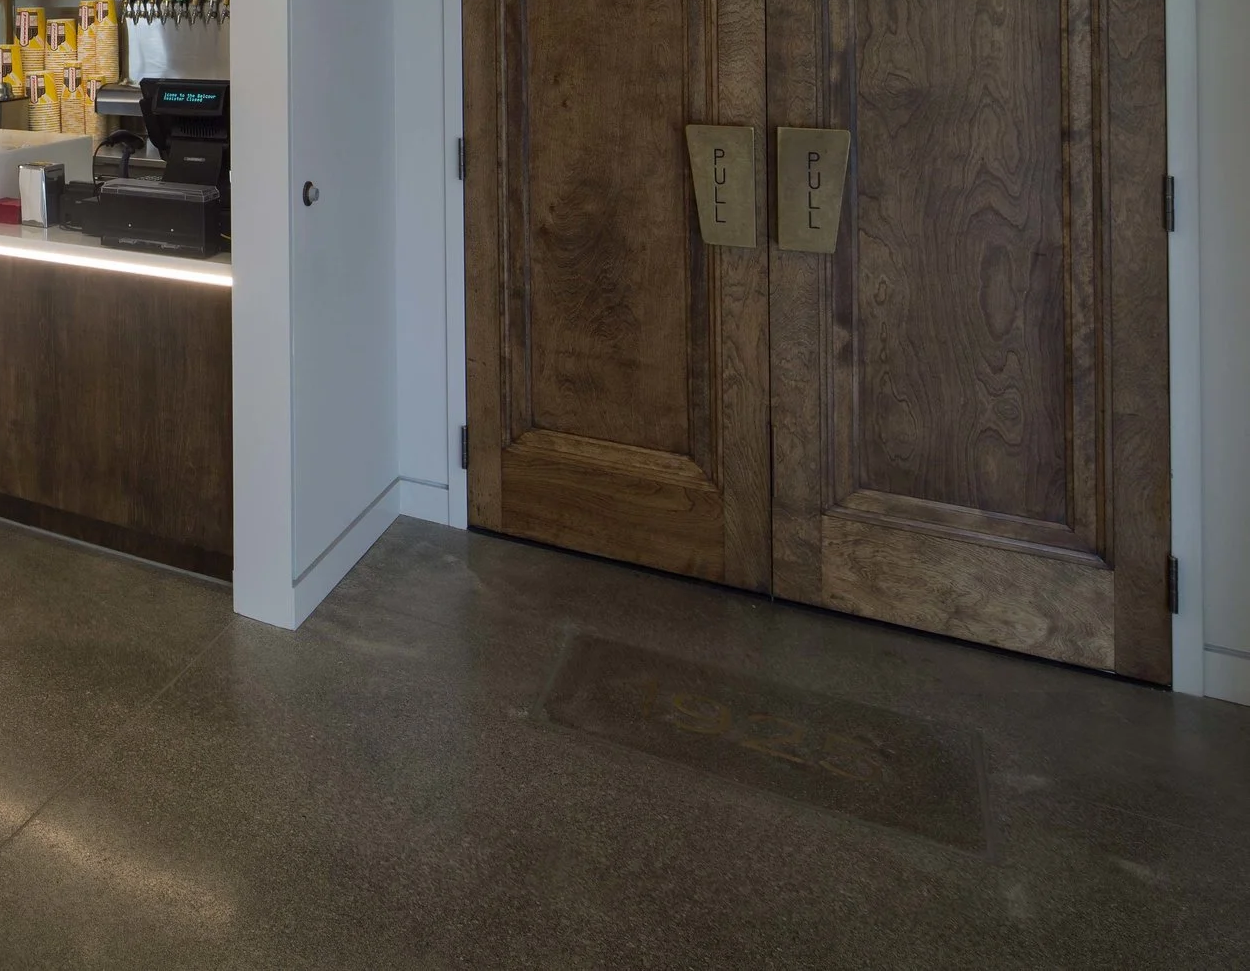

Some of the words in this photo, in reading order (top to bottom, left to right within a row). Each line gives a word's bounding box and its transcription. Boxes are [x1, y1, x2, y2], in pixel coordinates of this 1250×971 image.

[714, 148, 726, 223] PULL
[808, 151, 821, 230] PULL
[636, 679, 883, 781] 1925
